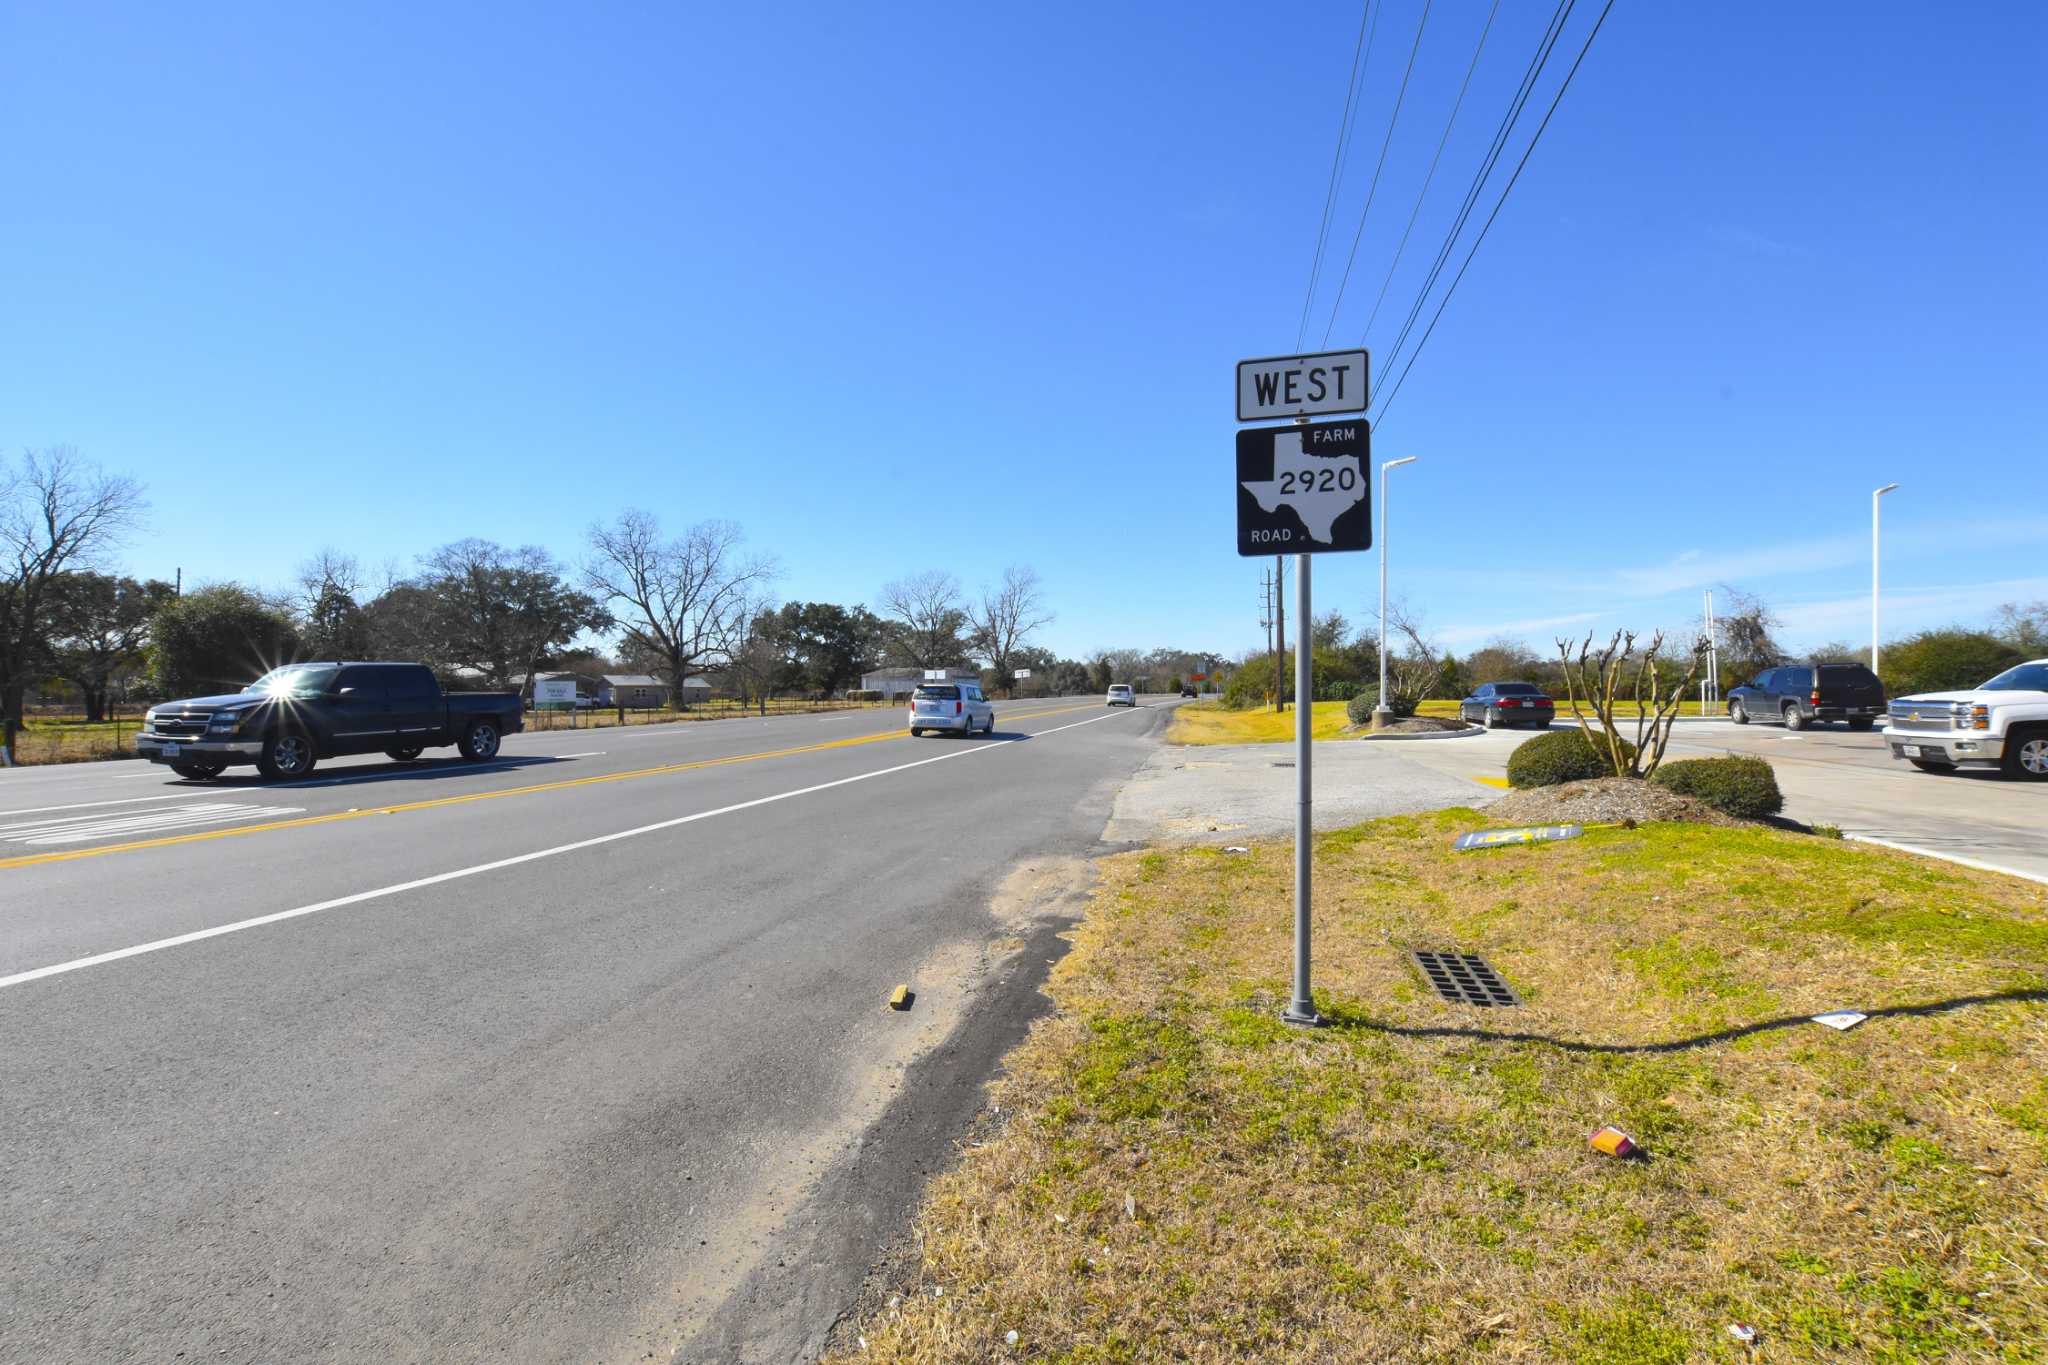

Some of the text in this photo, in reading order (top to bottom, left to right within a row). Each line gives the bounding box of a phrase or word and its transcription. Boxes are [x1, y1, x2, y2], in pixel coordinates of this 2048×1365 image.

[1254, 366, 1350, 406] WEST
[1313, 428, 1355, 443] FARM
[1280, 467, 1355, 494] 2920
[1251, 529, 1292, 542] ROAD
